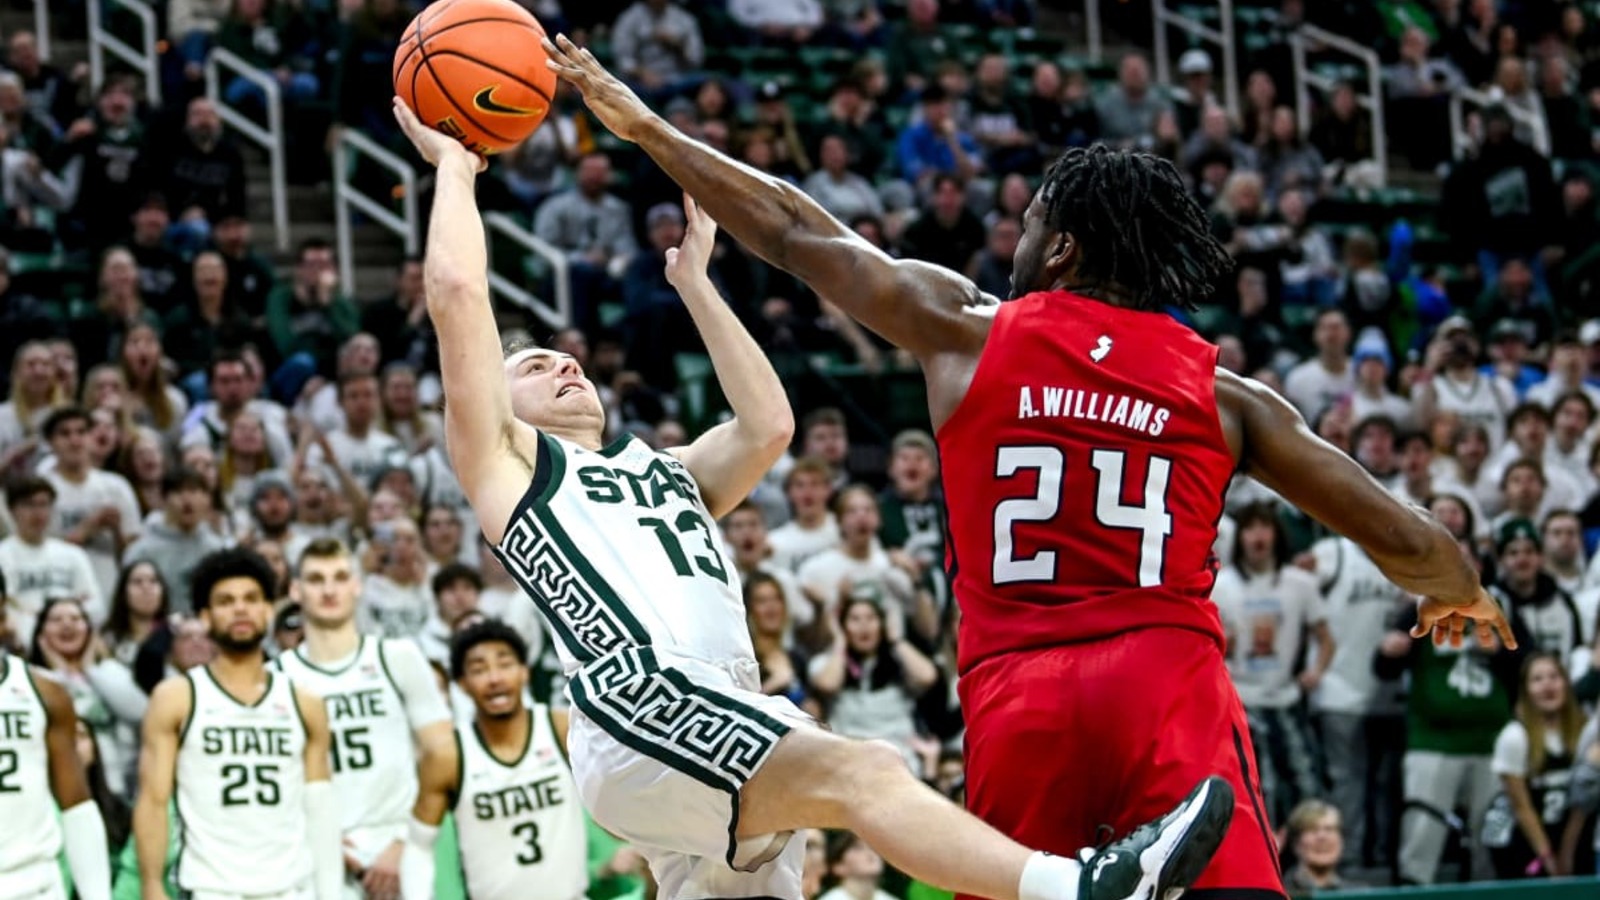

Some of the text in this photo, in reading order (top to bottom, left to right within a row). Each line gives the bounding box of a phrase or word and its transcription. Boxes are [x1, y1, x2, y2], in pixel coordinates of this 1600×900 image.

[1018, 386, 1170, 436] A.WILLIAMS
[577, 458, 699, 508] STA
[993, 446, 1172, 588] 24
[637, 509, 729, 586] 13
[324, 689, 386, 719] ATE
[203, 726, 293, 757] STATE
[329, 728, 373, 773] 15
[220, 763, 281, 807] 25
[473, 775, 564, 820] STATE
[511, 821, 543, 866] 3
